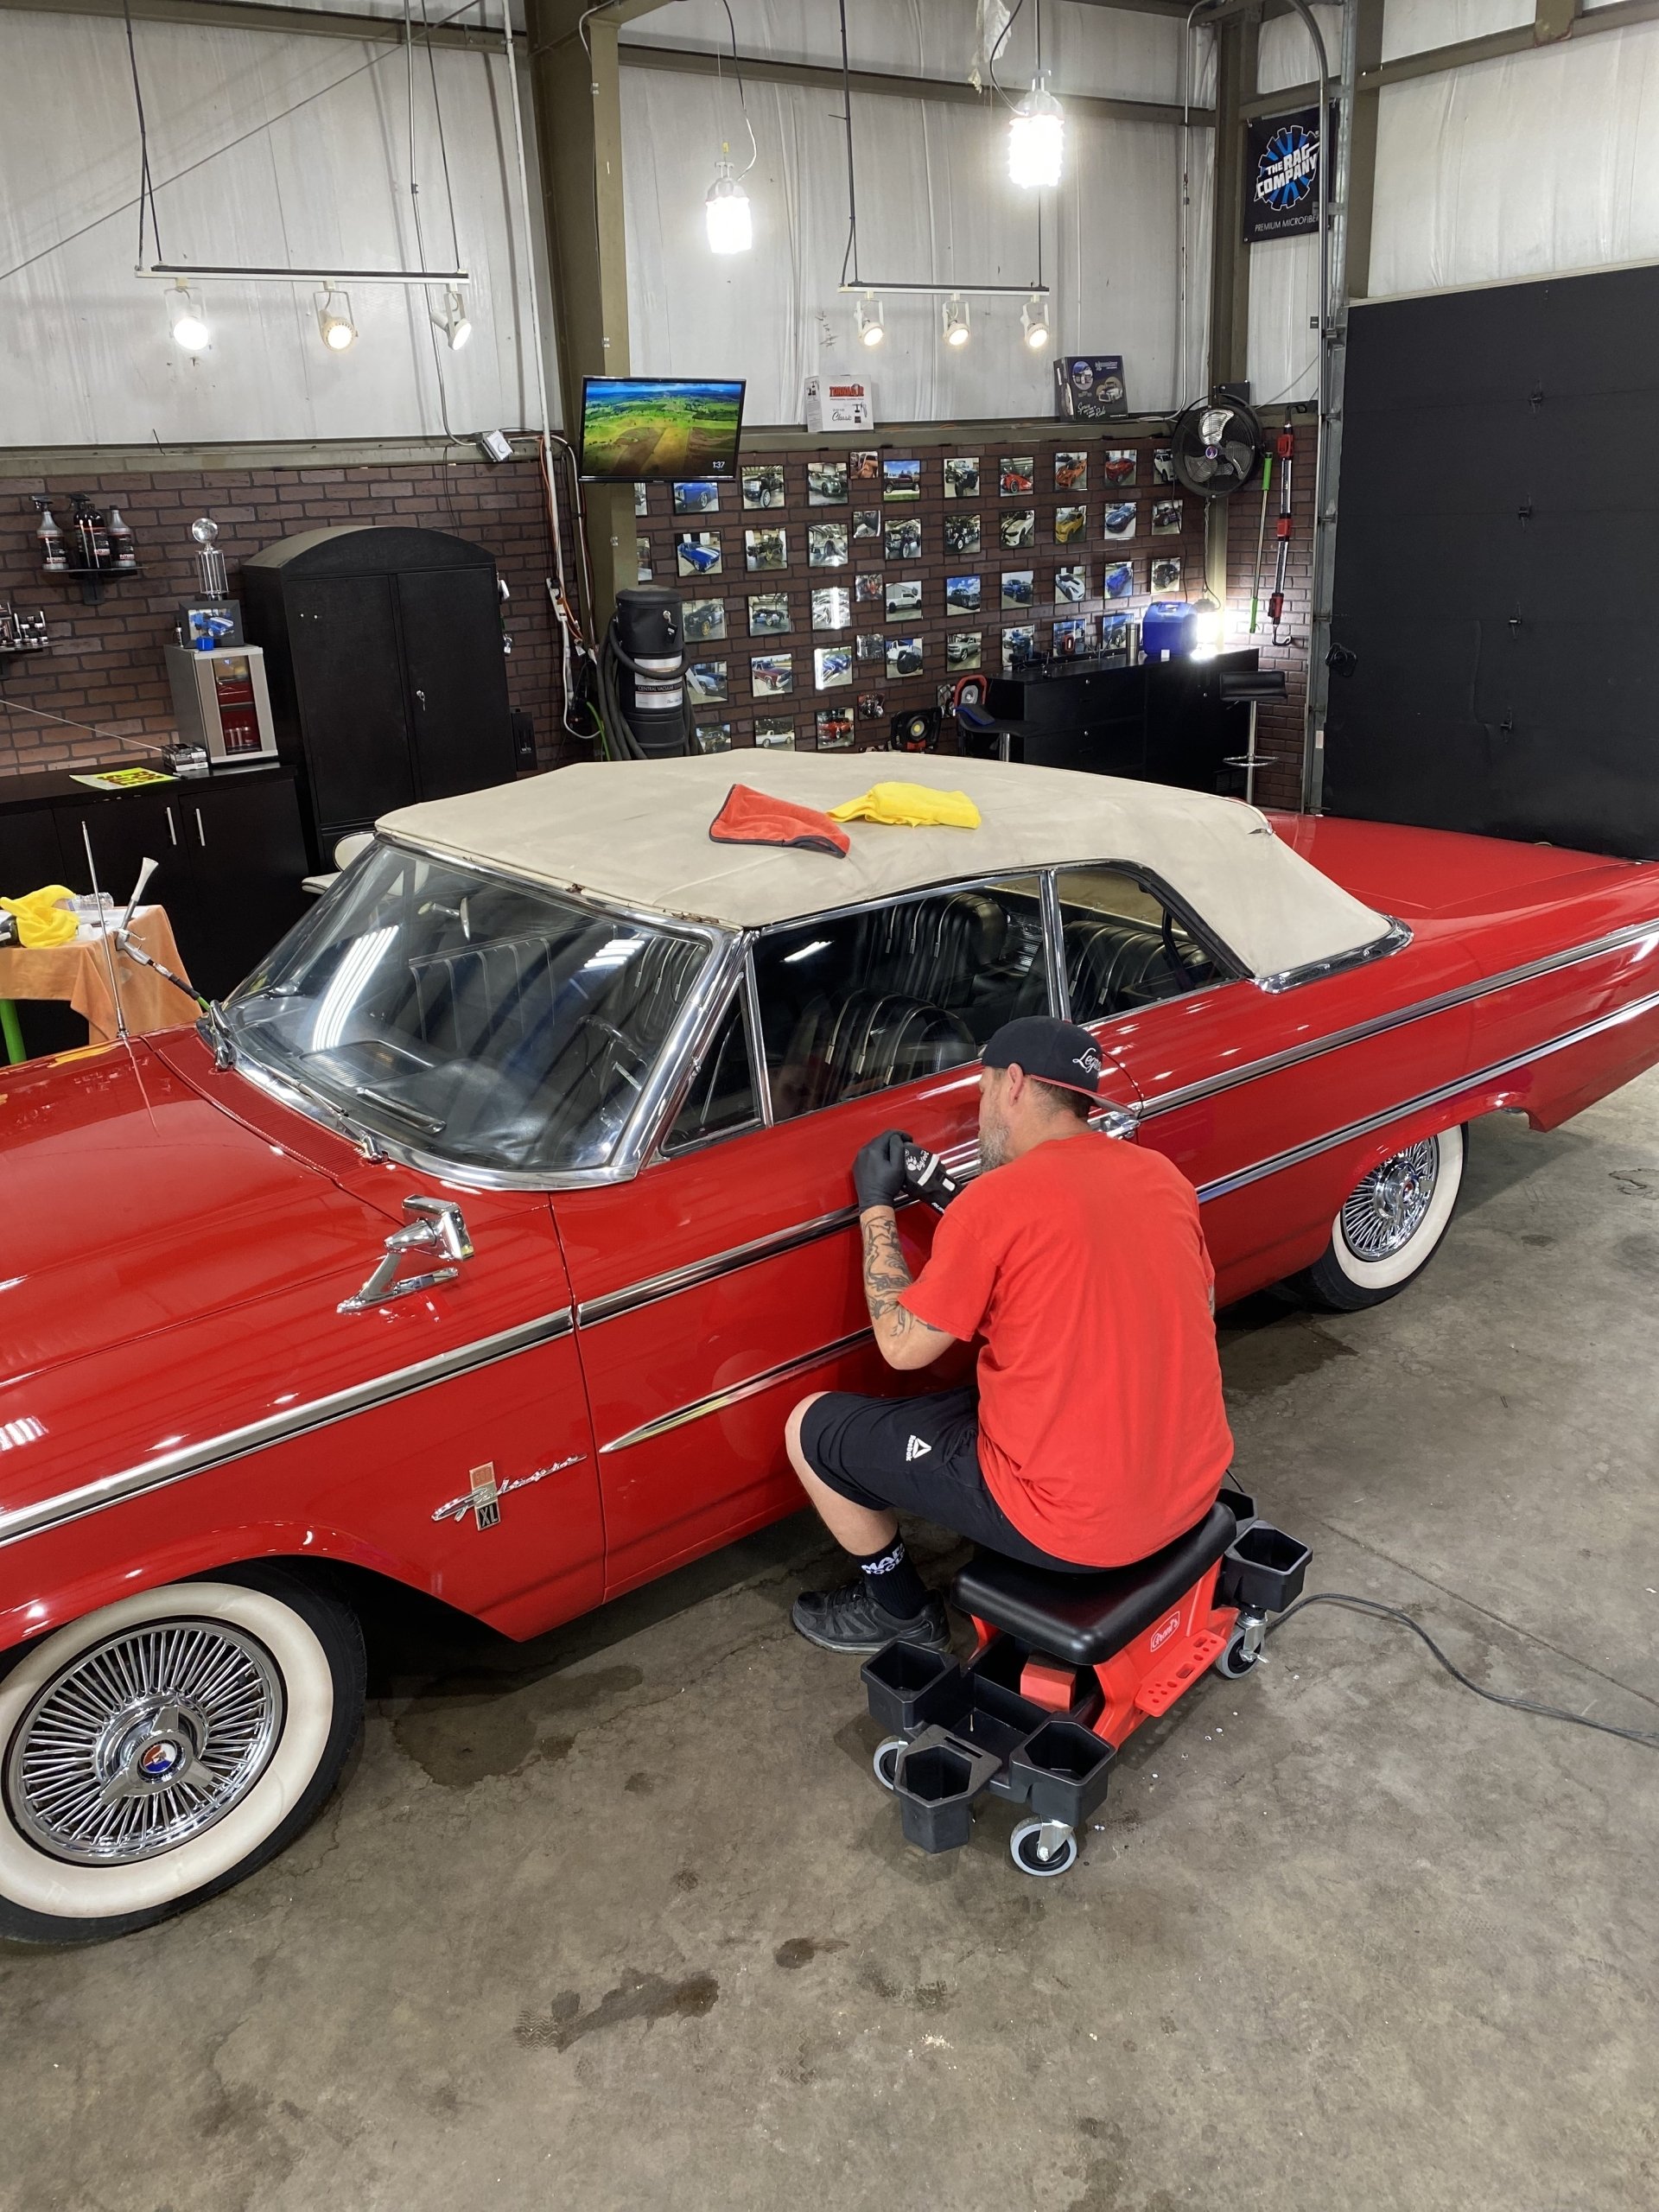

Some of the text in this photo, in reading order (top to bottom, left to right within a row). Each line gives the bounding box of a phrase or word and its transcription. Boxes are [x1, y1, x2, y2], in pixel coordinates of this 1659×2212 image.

[1265, 142, 1319, 175] THE RAG
[1257, 153, 1318, 198] COMPANY
[1255, 220, 1281, 232] PREMIUM
[832, 411, 852, 422] Classic
[906, 1434, 917, 1461] Reebok
[480, 1505, 499, 1528] XL
